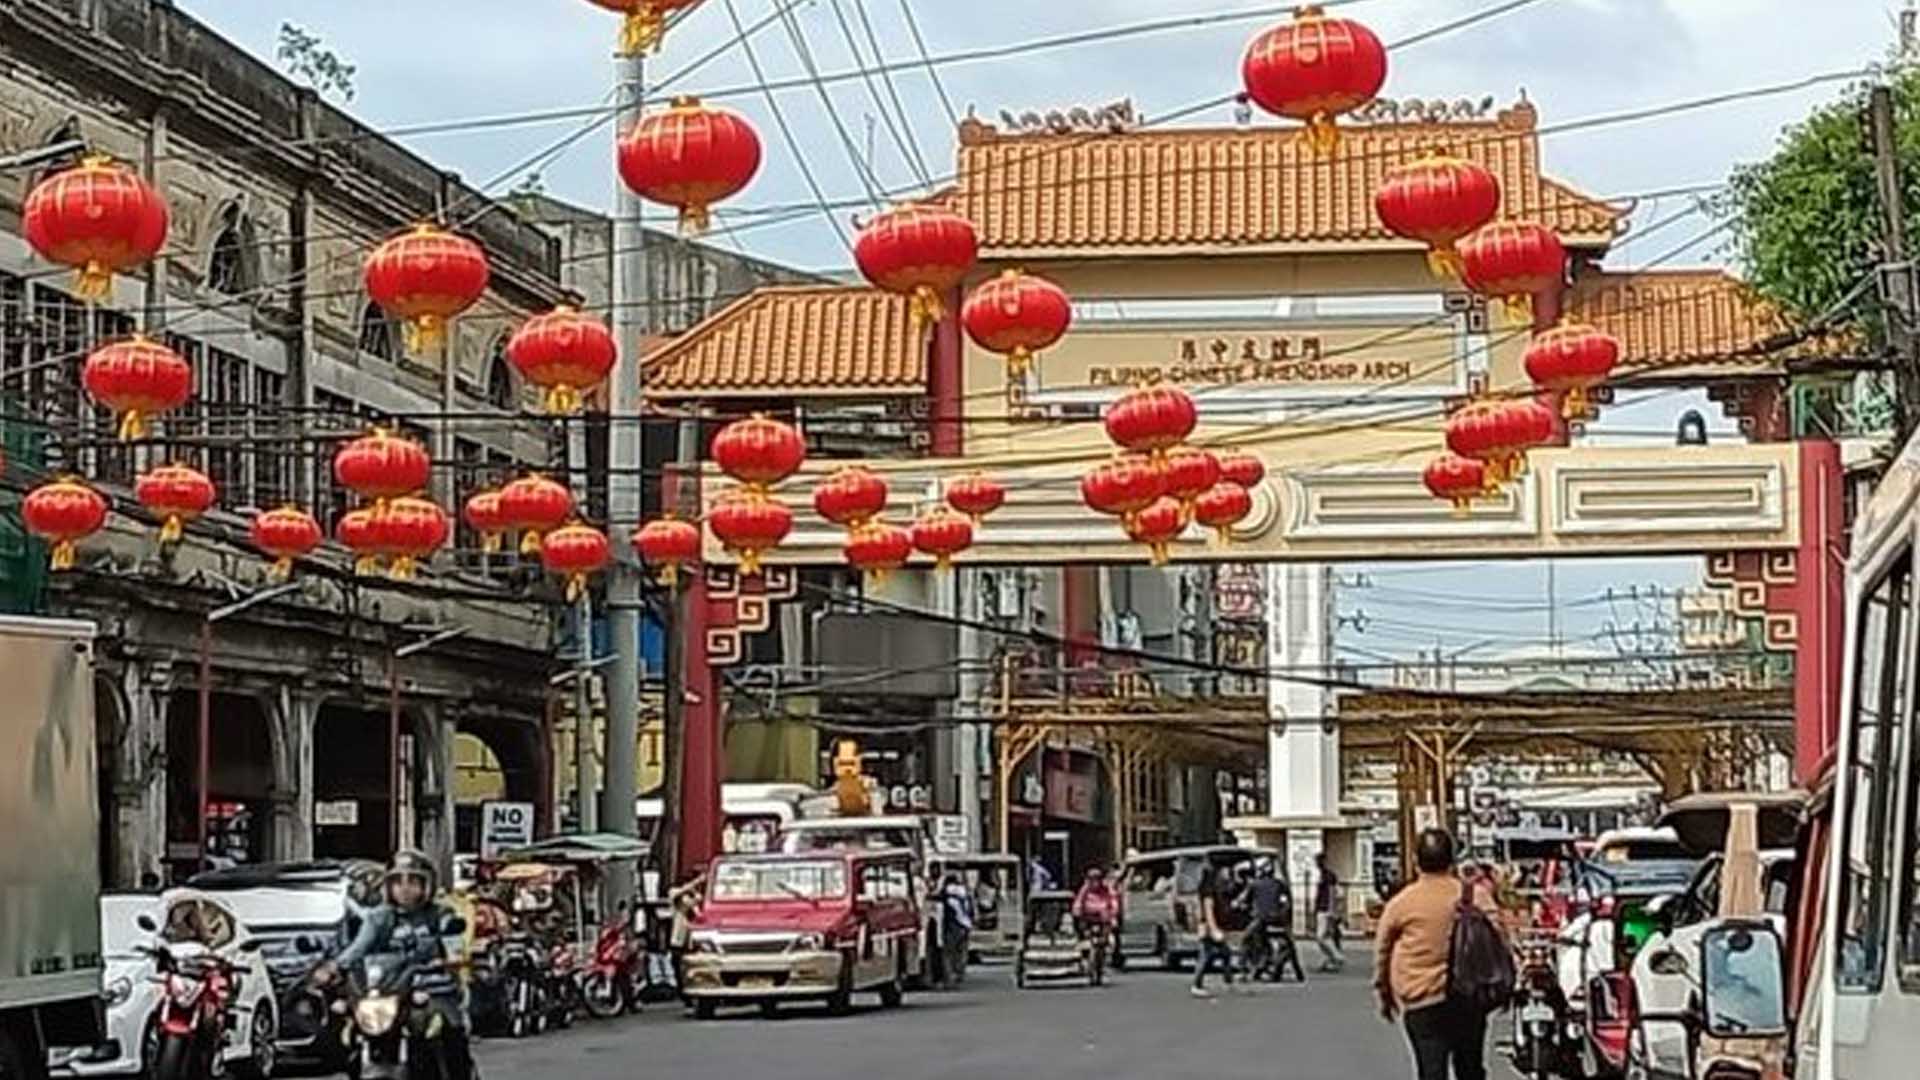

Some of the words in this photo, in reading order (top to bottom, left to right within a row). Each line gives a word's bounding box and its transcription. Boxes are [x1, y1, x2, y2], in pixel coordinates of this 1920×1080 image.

[1252, 362, 1358, 381] FRIENDSHIP
[1363, 360, 1411, 380] ARCH
[492, 807, 523, 825] NO
